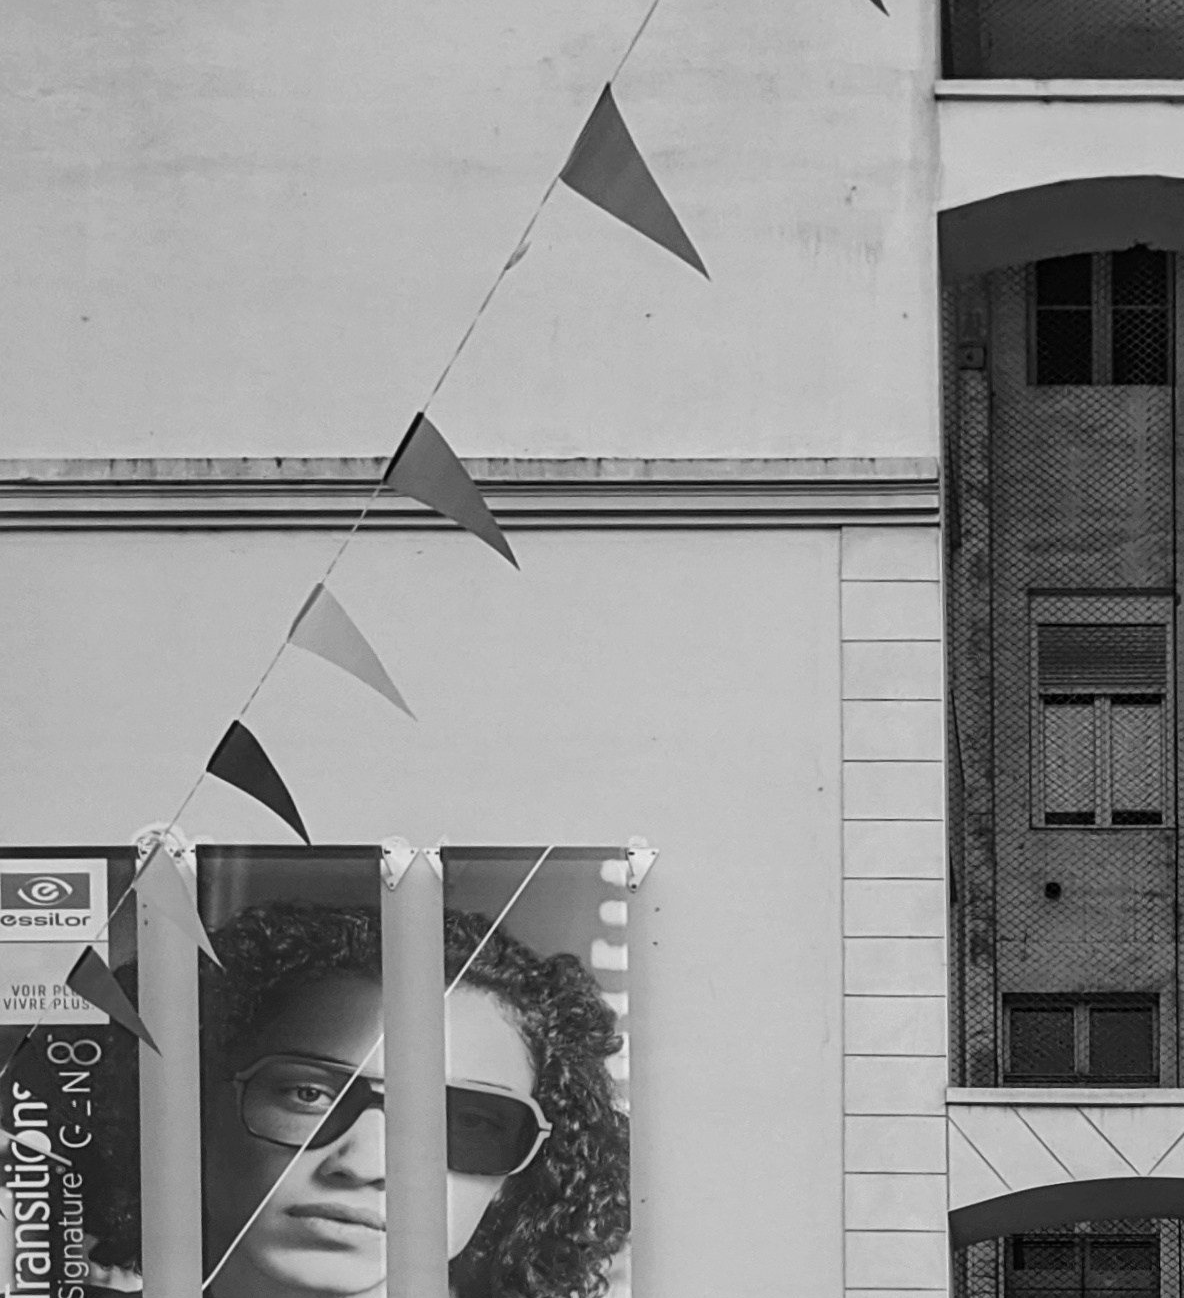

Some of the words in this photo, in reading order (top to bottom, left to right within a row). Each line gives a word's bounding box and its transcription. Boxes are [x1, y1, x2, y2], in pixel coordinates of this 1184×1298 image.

[0, 912, 92, 927] essilor
[11, 984, 47, 997] VOIR
[3, 998, 46, 1010] VIVRE
